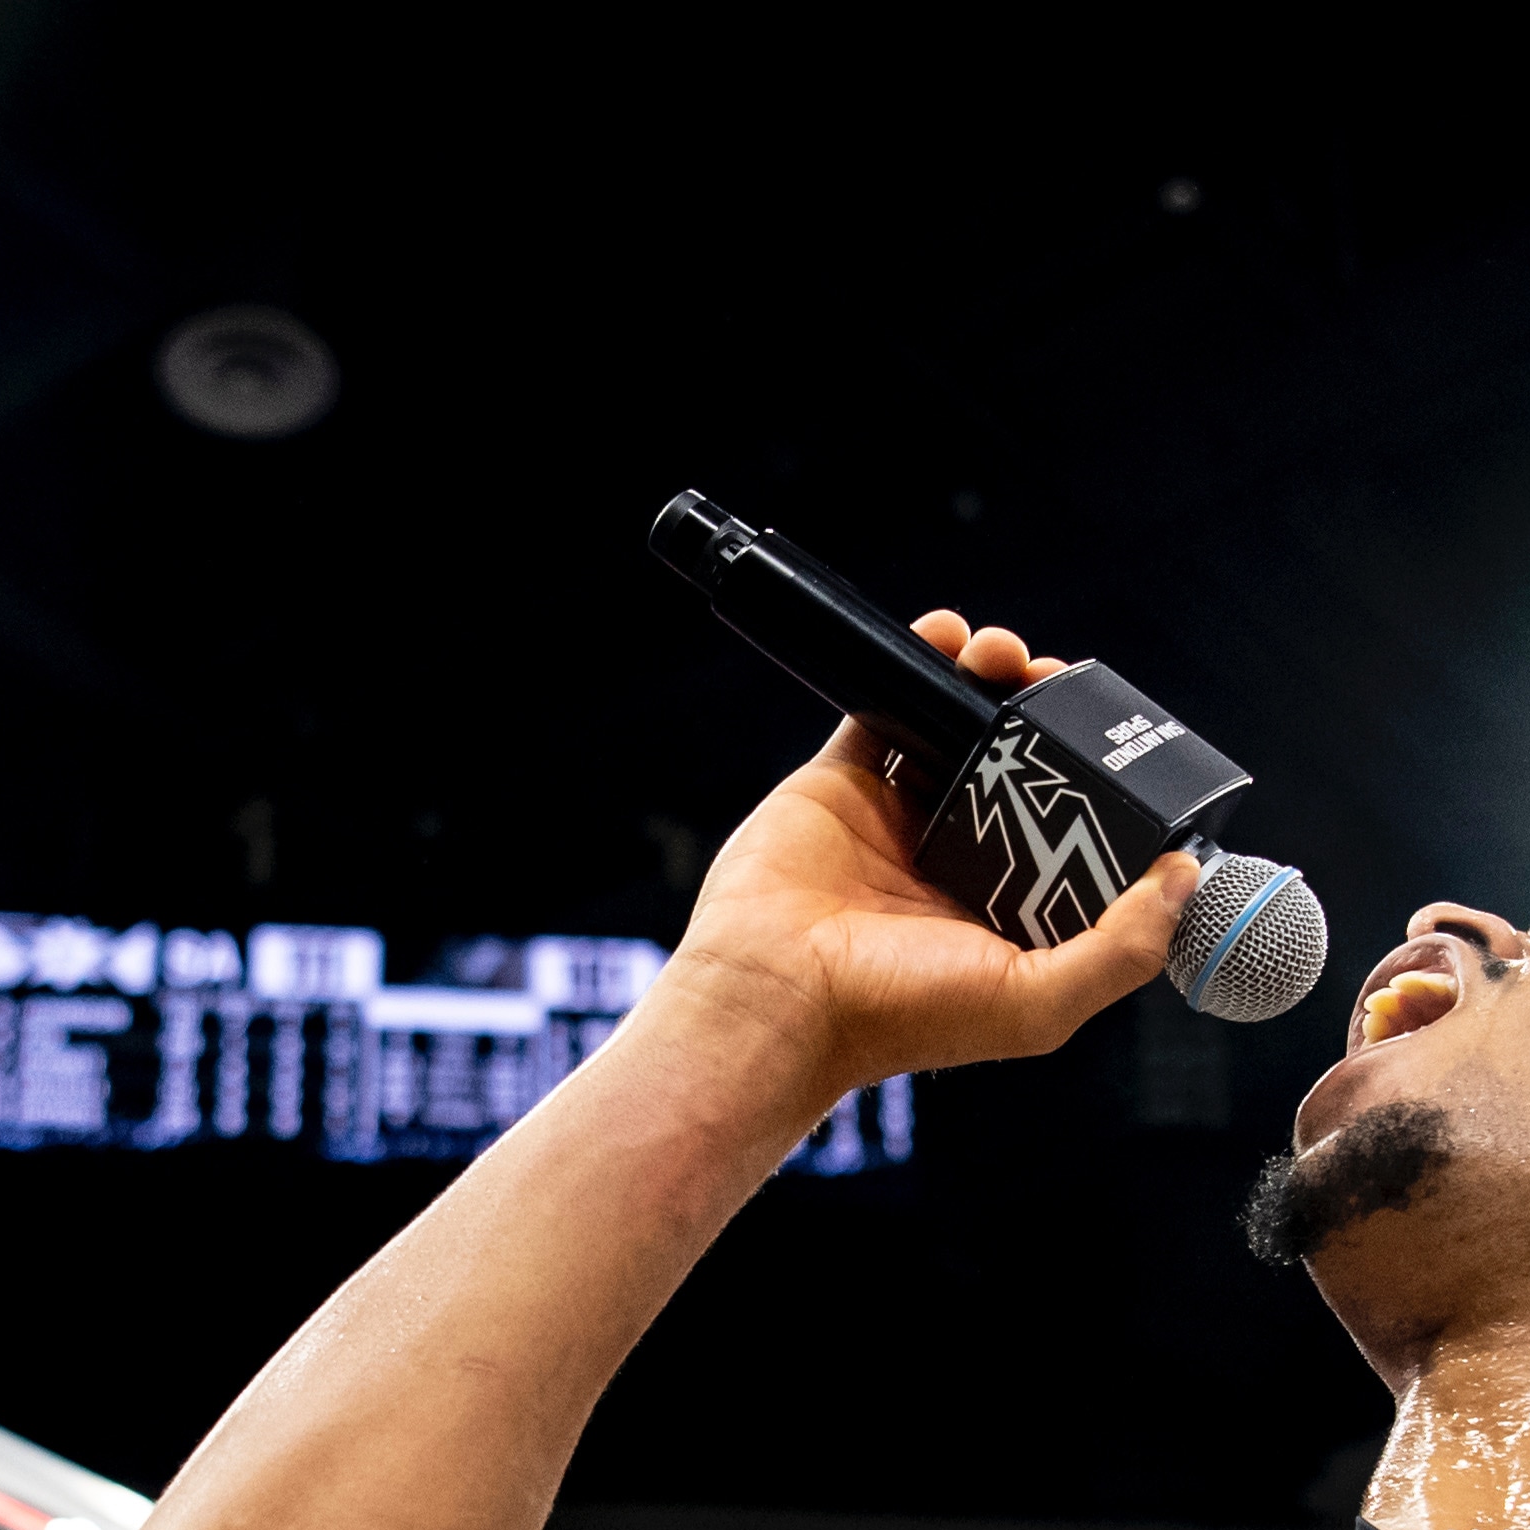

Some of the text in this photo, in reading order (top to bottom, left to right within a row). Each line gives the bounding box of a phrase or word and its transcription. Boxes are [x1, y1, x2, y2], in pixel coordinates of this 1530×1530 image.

[1101, 720, 1186, 772] SAN ANTONIO
[1104, 714, 1153, 745] SPURS
